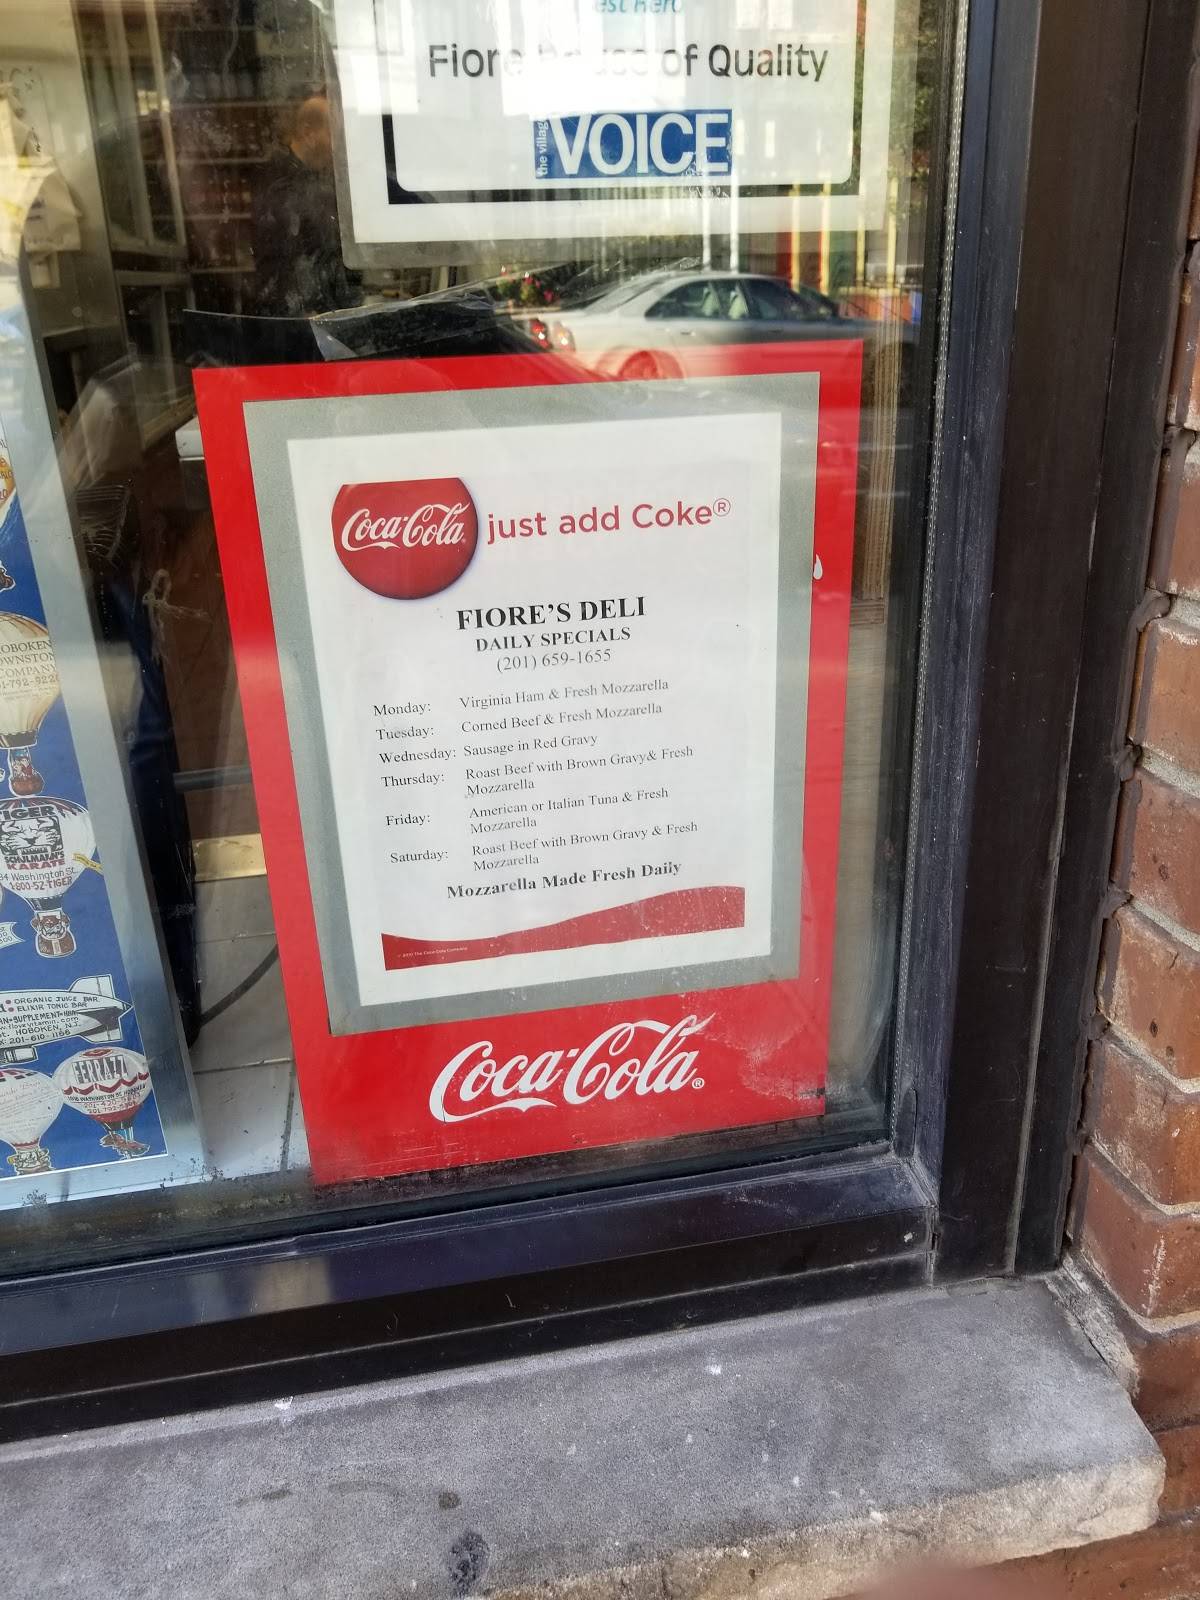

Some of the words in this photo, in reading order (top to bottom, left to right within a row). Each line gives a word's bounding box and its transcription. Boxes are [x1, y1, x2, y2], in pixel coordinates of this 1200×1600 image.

[661, 43, 698, 76] of
[708, 43, 828, 82] Quality
[536, 118, 549, 154] villag
[549, 112, 729, 175] VOICE
[341, 502, 470, 551] Coca-Cola
[487, 511, 547, 545] just
[559, 505, 620, 535] add
[578, 596, 647, 621] DELI
[0, 640, 54, 653] OBOKEN
[476, 634, 535, 652] DAILY
[541, 626, 631, 647] SPECIALS
[497, 655, 537, 674] (201)
[542, 648, 611, 667] 659-1655
[374, 702, 431, 717] Monday:
[459, 694, 512, 710] Virginia
[516, 691, 544, 703] Ham
[548, 688, 560, 700] &
[565, 684, 598, 698] Fresh
[602, 679, 669, 695] Mozzarella
[376, 727, 434, 740] Tuesday:
[461, 718, 507, 733] Corned
[511, 714, 541, 728] Beef
[544, 713, 554, 725] &
[559, 709, 592, 723] Fresh
[596, 703, 662, 719] Mozzarella
[379, 748, 456, 764] Wednesday:
[464, 744, 514, 757] Sausage
[518, 740, 529, 751] in
[534, 737, 557, 750] Red
[561, 734, 598, 747] Gravy
[381, 772, 445, 787] Thursday:
[466, 767, 500, 780] Roast
[504, 762, 534, 775] Beef
[536, 759, 563, 773] with
[567, 758, 607, 770] Brown
[662, 746, 693, 760] Fresh
[467, 779, 535, 796] Mozzarella
[0, 806, 55, 820] IGER
[386, 813, 431, 827] Friday:
[469, 804, 527, 818] American
[531, 802, 544, 811] or
[548, 797, 585, 811] Italian
[589, 795, 618, 806] Tuna
[622, 791, 633, 802] &
[637, 787, 669, 801] Fresh
[390, 850, 449, 864] Saturday:
[472, 843, 506, 856] Roast
[510, 838, 539, 851] Beef
[541, 835, 567, 848] with
[570, 832, 609, 845] Brown
[612, 828, 648, 841] Gravy
[651, 825, 662, 836] &
[667, 821, 698, 834] Fresh
[470, 817, 537, 834] Mozzarella
[11, 870, 66, 881] Washington
[447, 876, 536, 899] Mozzarella
[543, 871, 586, 889] Made
[592, 866, 635, 882] Fresh
[642, 861, 682, 877] Daily
[474, 854, 539, 871] Mozzarella
